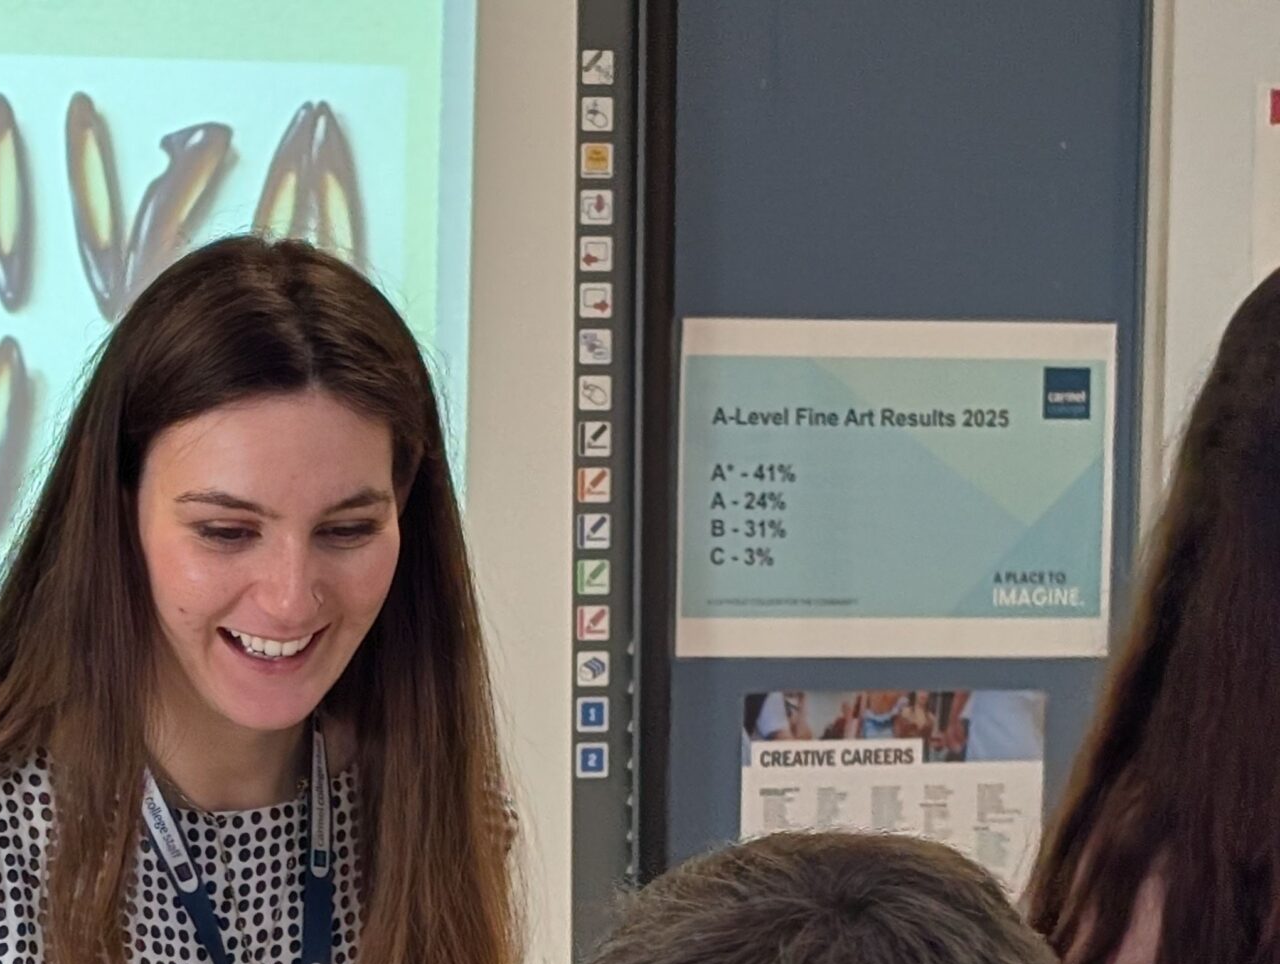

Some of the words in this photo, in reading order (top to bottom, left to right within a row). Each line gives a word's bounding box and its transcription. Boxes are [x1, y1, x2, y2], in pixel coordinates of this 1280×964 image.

[711, 407, 789, 426] A-Level
[795, 407, 840, 427] Fine
[843, 407, 875, 427] Art
[880, 409, 956, 428] Results
[962, 409, 1010, 428] 2025
[753, 463, 797, 483] 41%
[710, 491, 726, 510] A
[744, 491, 787, 511] 24%
[710, 519, 726, 537] B
[744, 519, 787, 538] 31%
[709, 547, 725, 566] C
[744, 547, 775, 566] 3%
[759, 749, 837, 767] CREATIVE
[840, 747, 915, 766] CAREERS
[144, 797, 169, 834] college
[162, 834, 183, 858] staff
